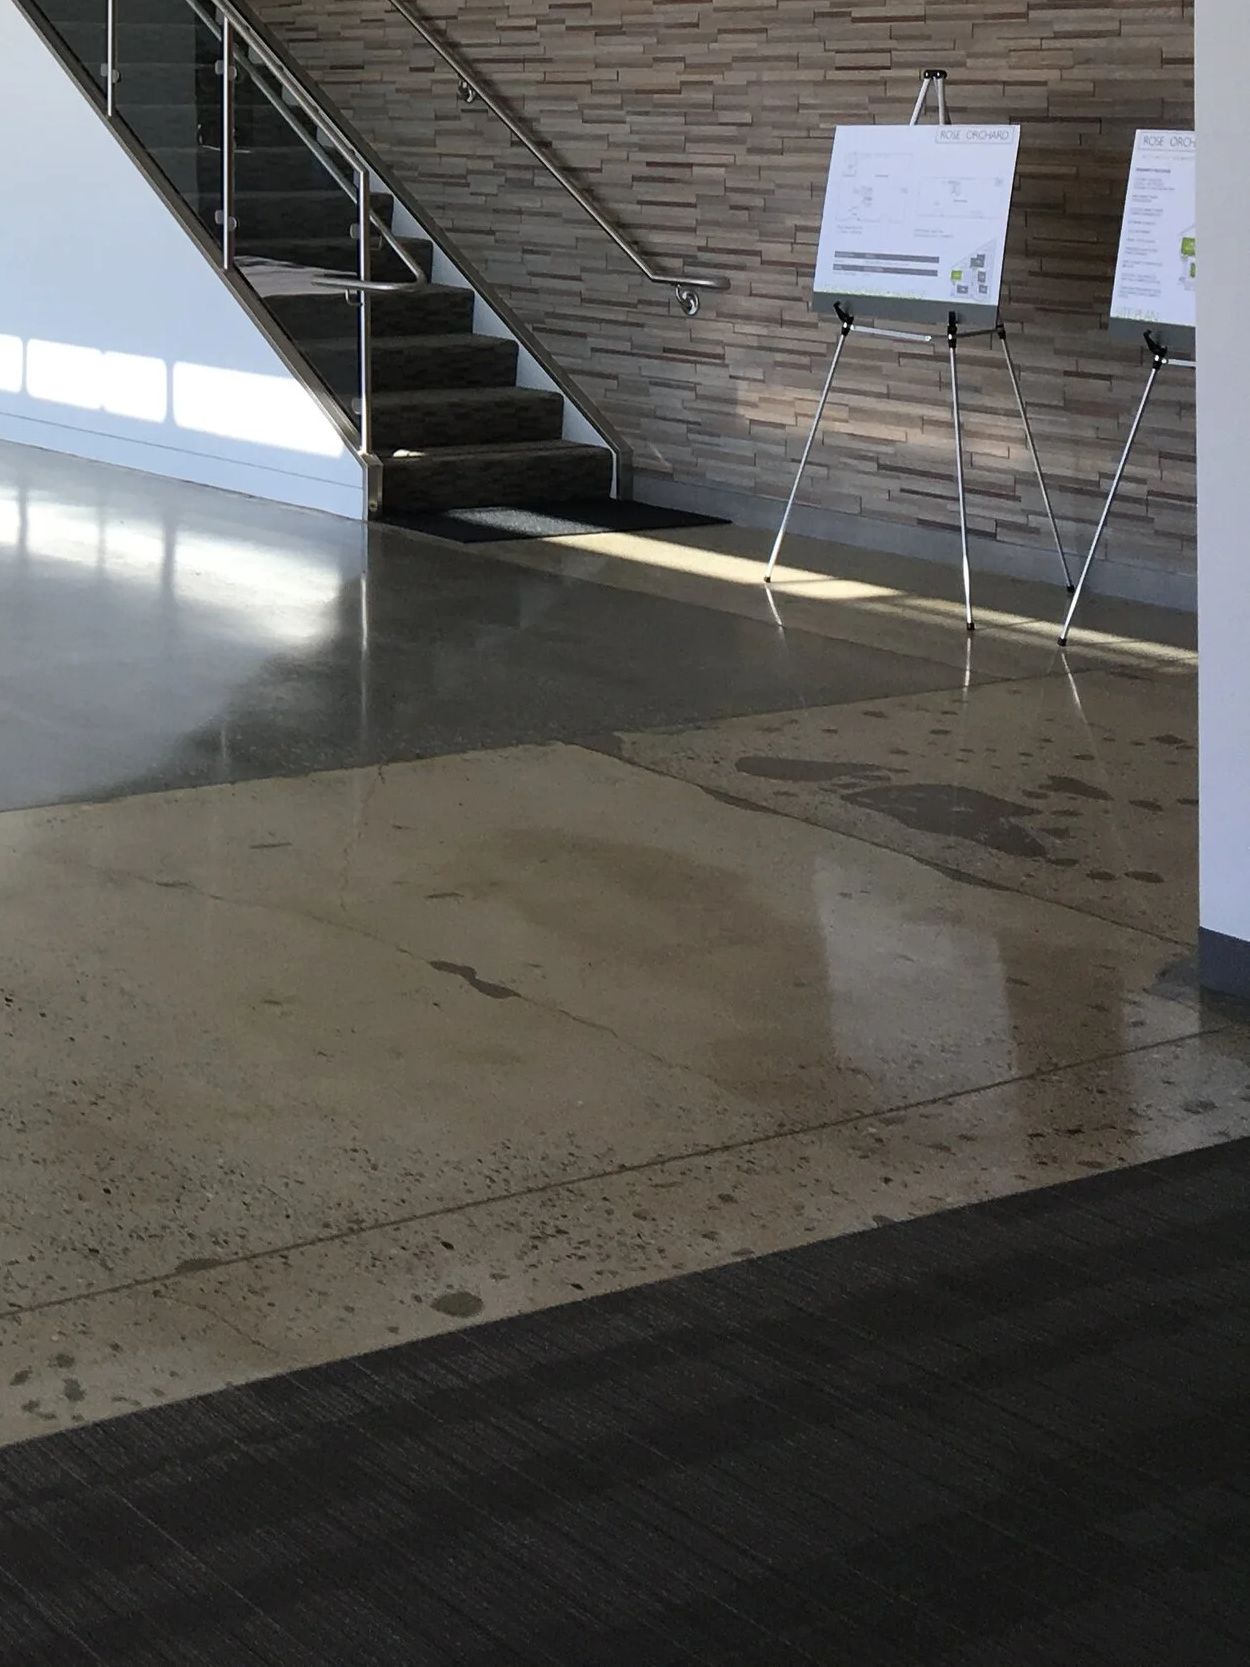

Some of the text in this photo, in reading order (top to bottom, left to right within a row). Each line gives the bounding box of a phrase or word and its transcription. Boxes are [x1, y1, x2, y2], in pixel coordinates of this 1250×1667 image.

[940, 129, 1010, 141] ROSE ORCHARD
[1143, 135, 1165, 147] ROSE
